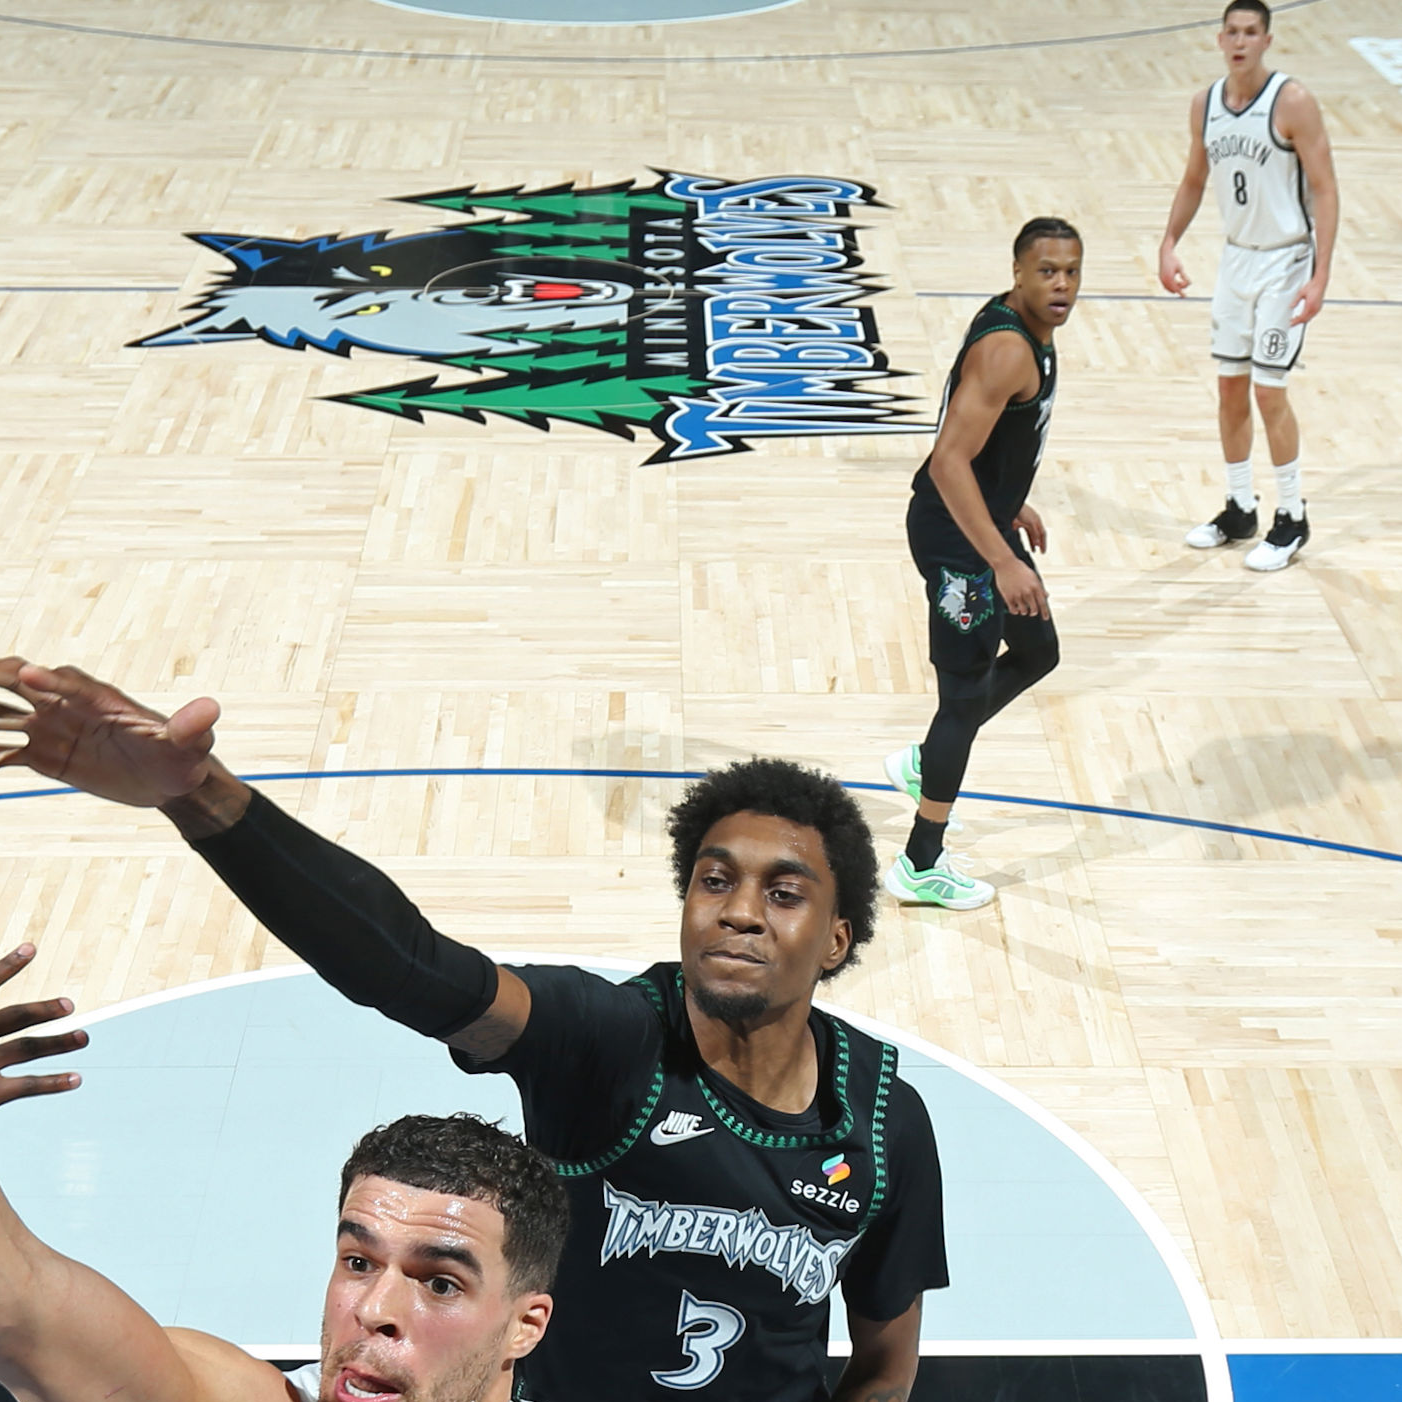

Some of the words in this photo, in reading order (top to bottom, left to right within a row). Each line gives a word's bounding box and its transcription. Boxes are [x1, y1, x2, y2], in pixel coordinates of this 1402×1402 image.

[1206, 133, 1274, 167] BROOKLYN
[1233, 170, 1248, 206] 8
[643, 217, 690, 368] MINNESOTA
[663, 174, 940, 459] TIMBERWOLVES
[660, 1110, 703, 1134] NIKE
[789, 1178, 861, 1214] sezzle
[600, 1177, 862, 1306] TIMBERWOLVES
[649, 1289, 747, 1391] 3
